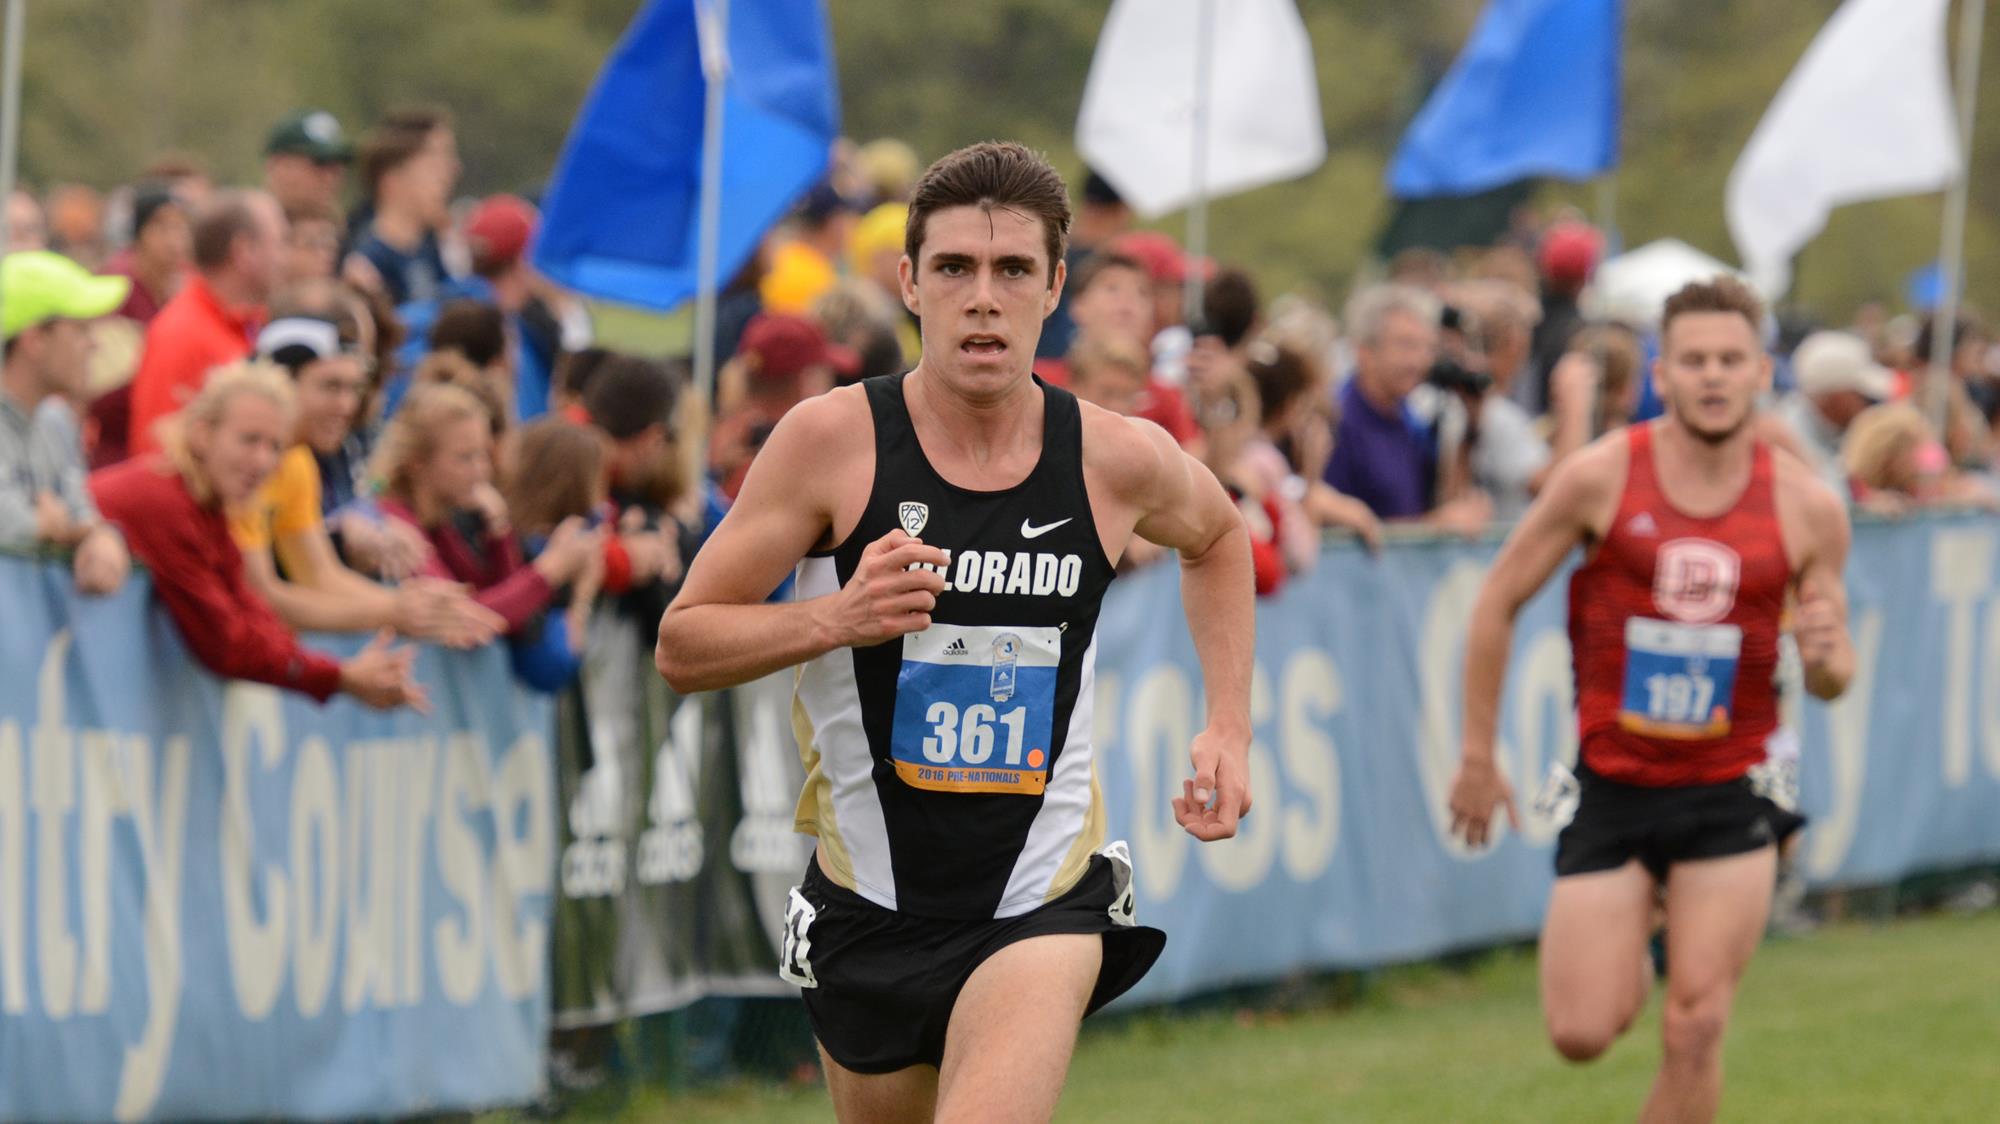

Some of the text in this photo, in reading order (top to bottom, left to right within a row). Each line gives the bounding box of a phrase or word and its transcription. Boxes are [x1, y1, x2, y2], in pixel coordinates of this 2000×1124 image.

[901, 504, 926, 523] PAC
[906, 518, 920, 530] 12
[906, 548, 1083, 598] LORADO
[1931, 530, 2000, 788] T
[1645, 673, 1715, 724] 197
[922, 701, 1027, 766] 361
[917, 767, 1020, 785] 2016 PRE-NATIONALS
[220, 678, 553, 1022] Course
